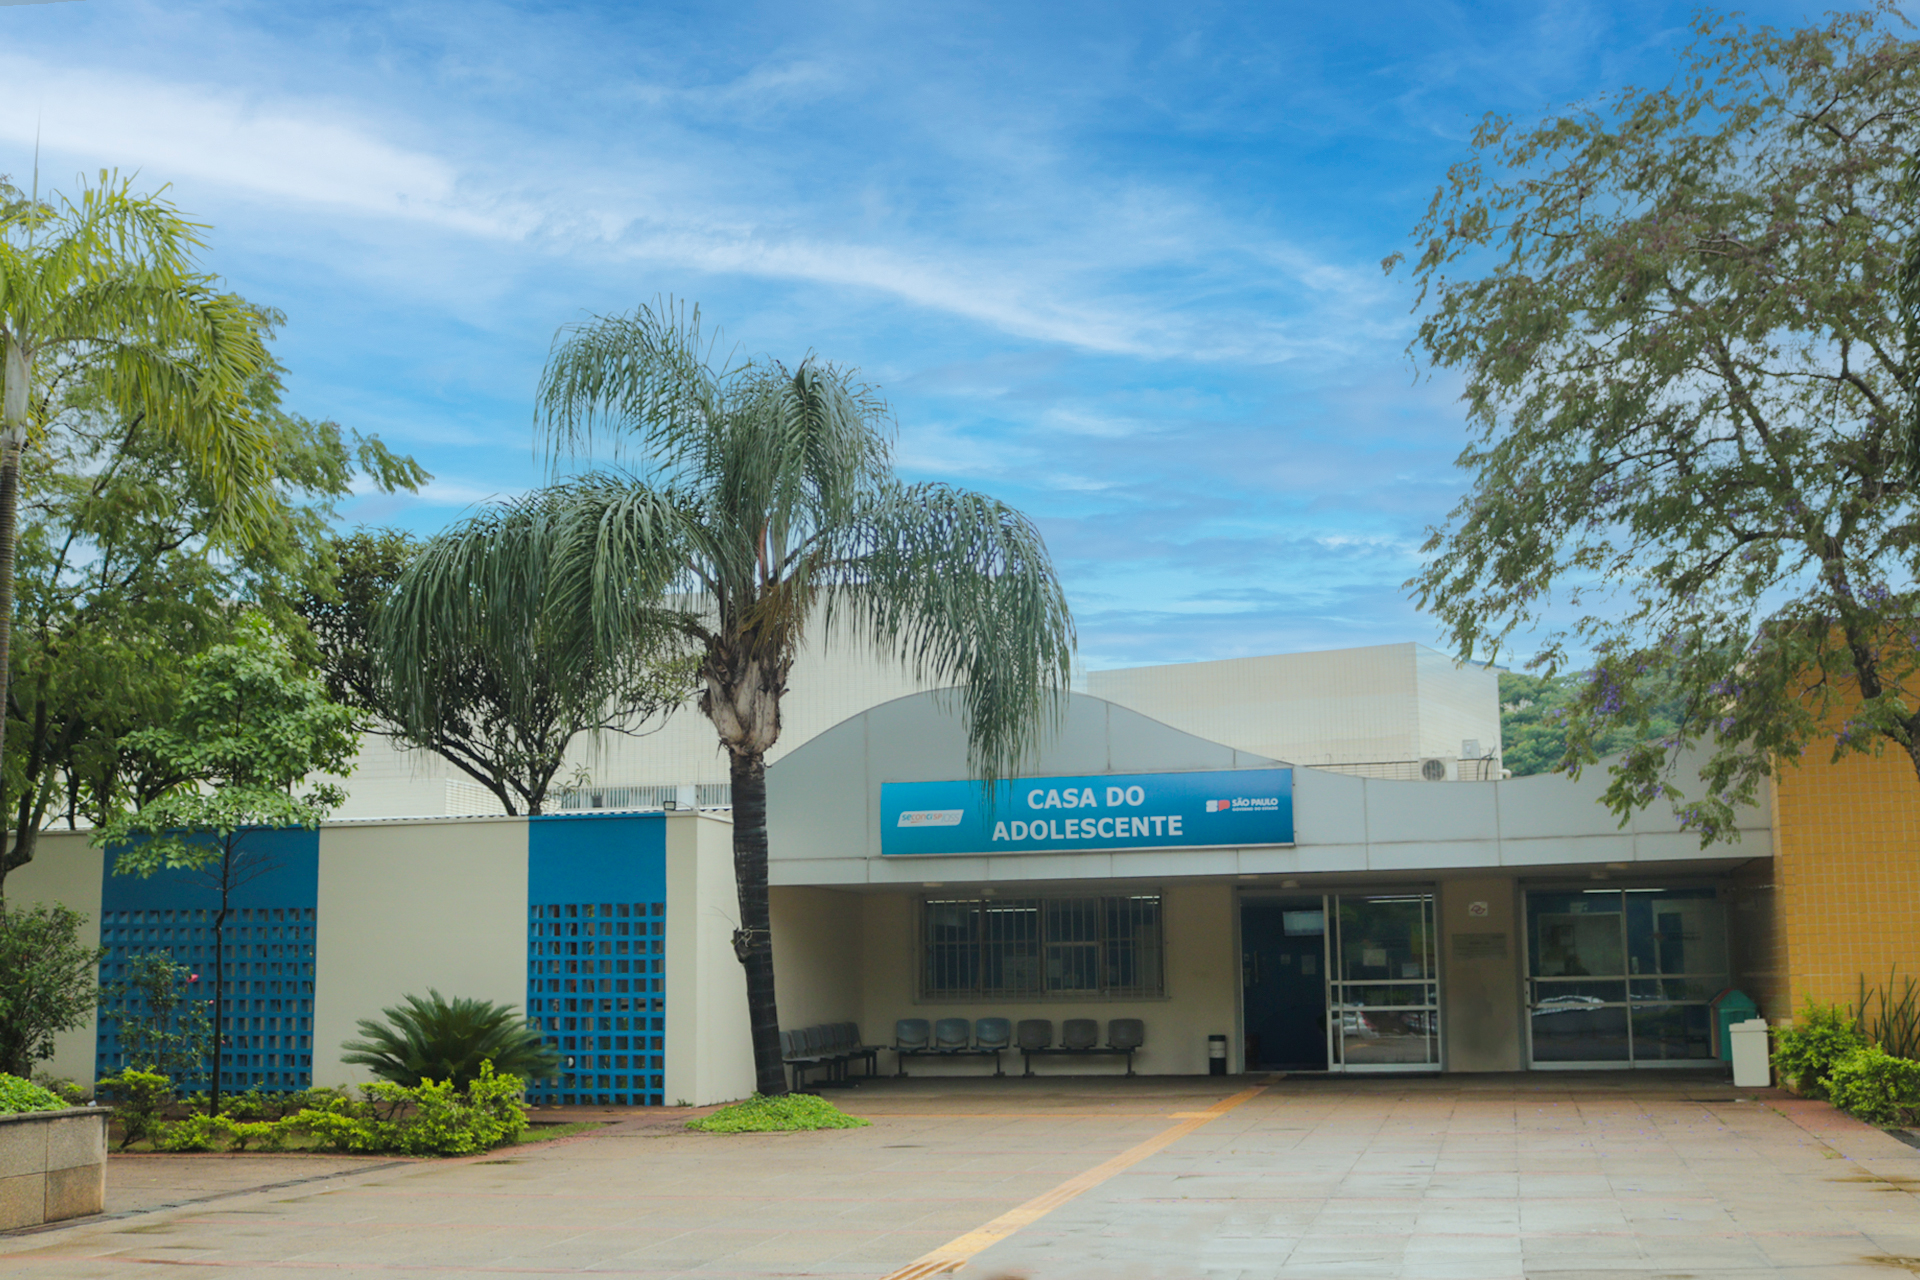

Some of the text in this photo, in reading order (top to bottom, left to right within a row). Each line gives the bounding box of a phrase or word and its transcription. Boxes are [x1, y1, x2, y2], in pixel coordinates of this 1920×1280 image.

[1027, 785, 1146, 810] CASA DO
[1231, 797, 1279, 807] SÃO PAULO
[991, 815, 1184, 841] ADOLESCENTE
